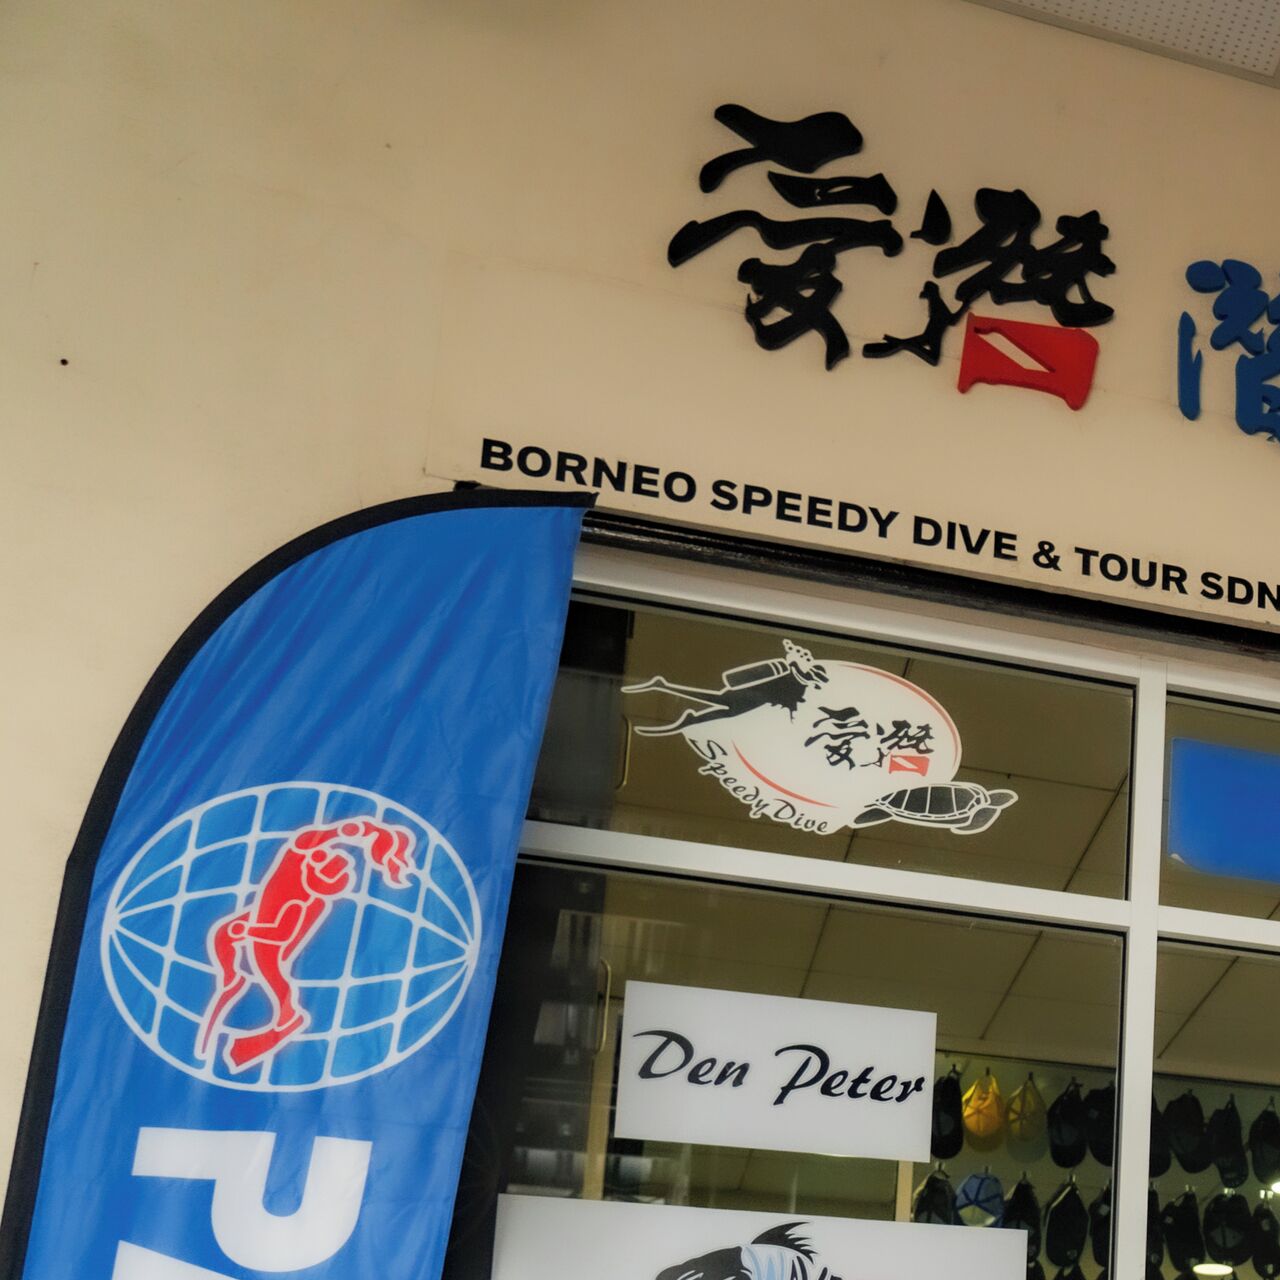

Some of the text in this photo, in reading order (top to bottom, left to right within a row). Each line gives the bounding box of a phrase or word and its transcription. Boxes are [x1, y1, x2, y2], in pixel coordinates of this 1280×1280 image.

[480, 438, 697, 503] BORNEO
[710, 479, 899, 538] SPEEDY
[912, 516, 1018, 560] DIVE
[1032, 540, 1061, 571] &
[1074, 545, 1188, 595] TOUR
[688, 737, 828, 835] Speedy Dive
[633, 1029, 926, 1107] Den Peter
